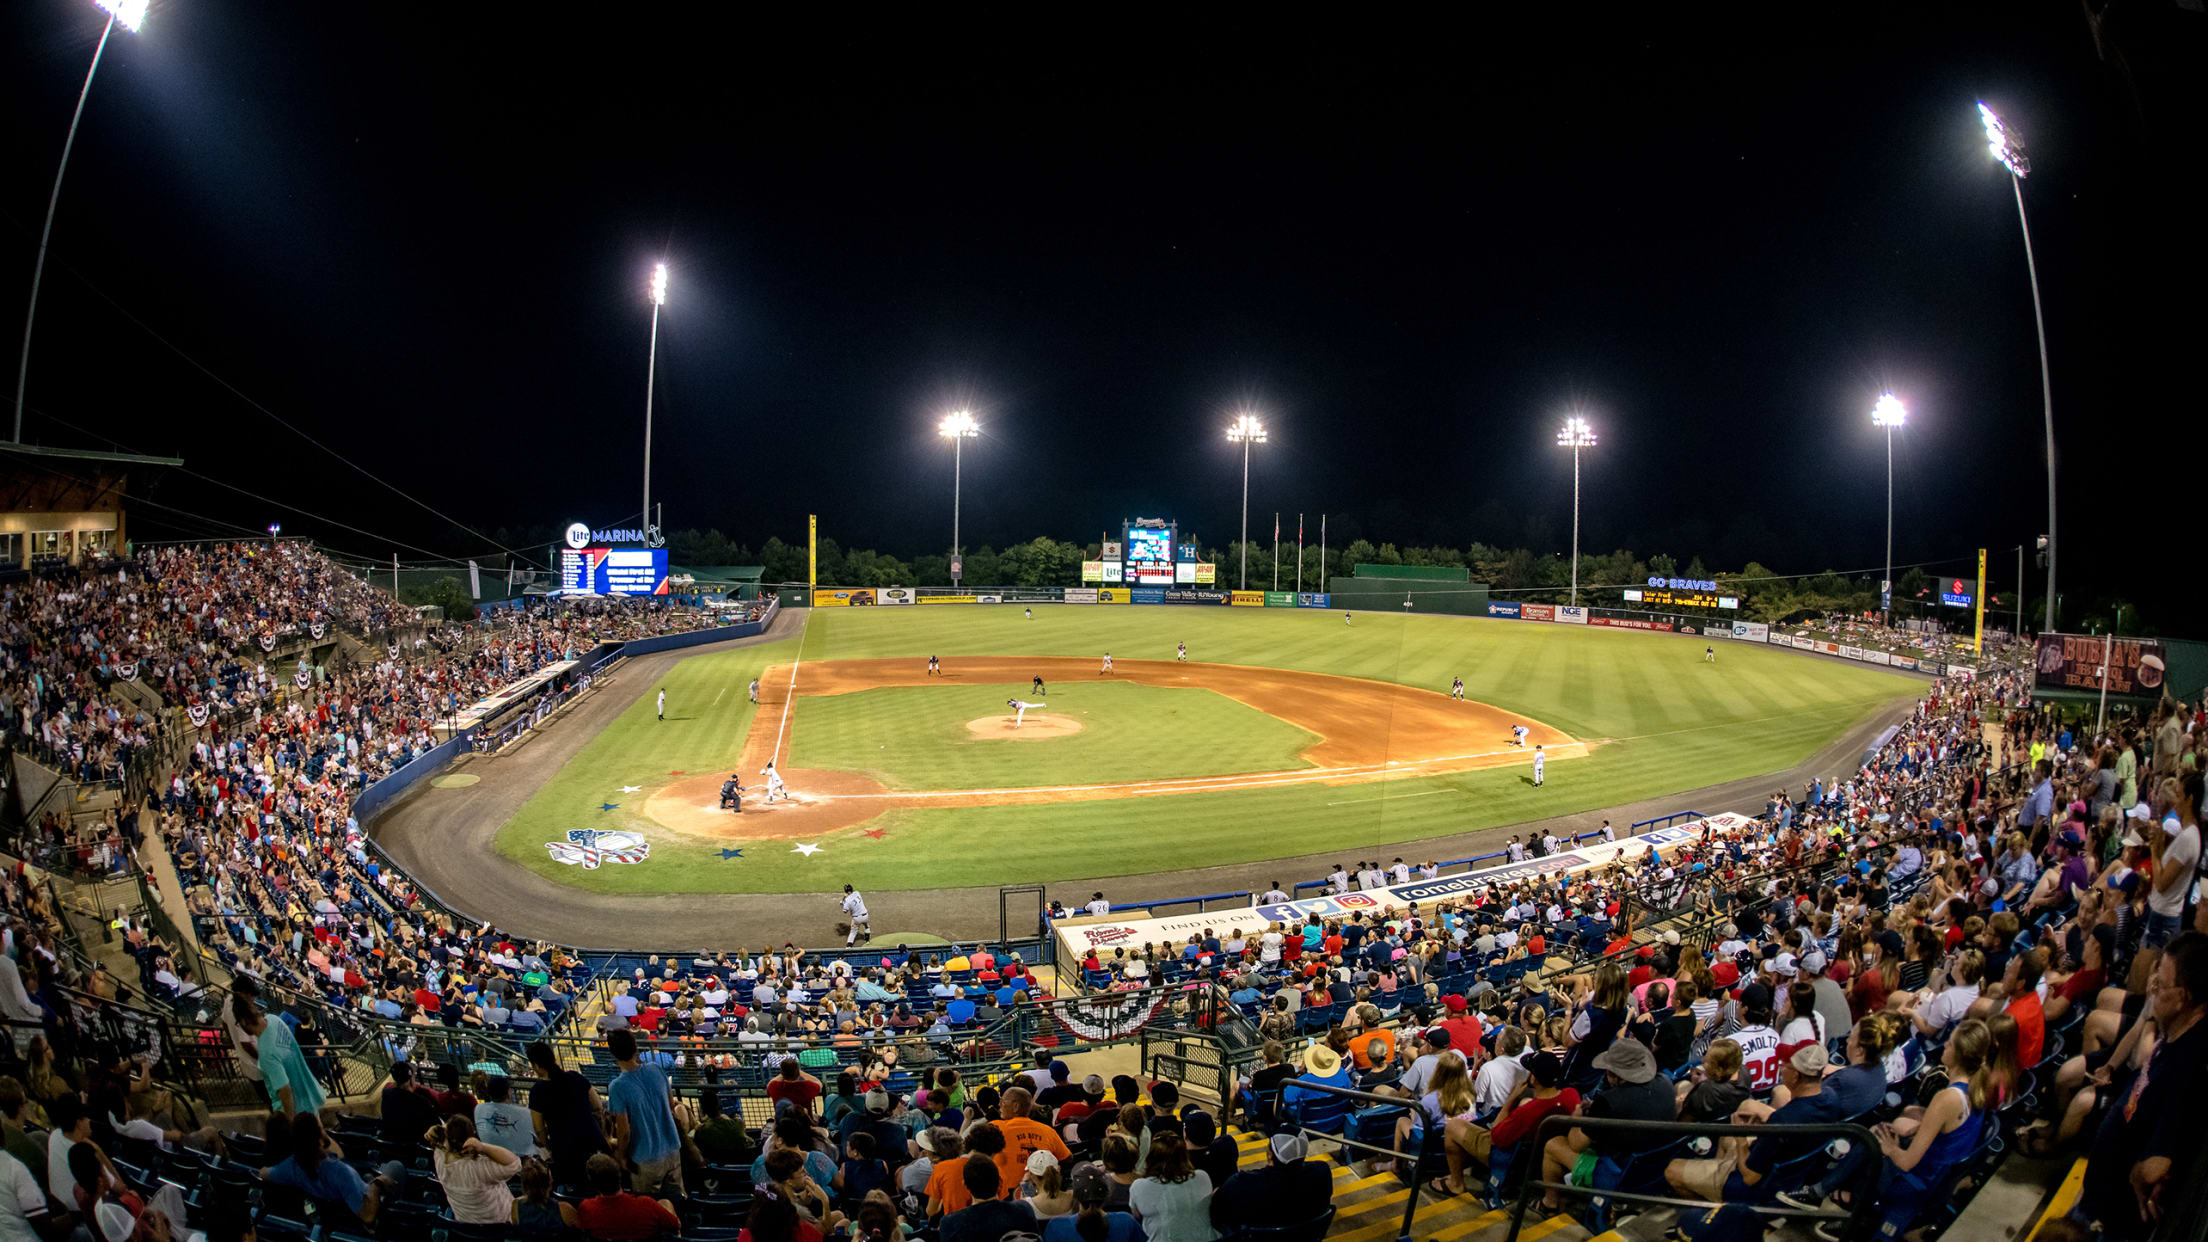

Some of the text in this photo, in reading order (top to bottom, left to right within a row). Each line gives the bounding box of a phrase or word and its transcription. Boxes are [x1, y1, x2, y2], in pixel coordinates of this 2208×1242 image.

[571, 529, 646, 543] Lite MARINA
[1106, 568, 1121, 578] Lite
[1647, 576, 1717, 591] GO BRAVES
[1942, 593, 1971, 604] SUZUKI
[1561, 606, 1581, 616] NGE
[2065, 673, 2132, 693] BARN
[1399, 854, 1584, 900] romebraves.com
[1097, 905, 1108, 913] 26
[1161, 921, 1201, 931] FIND
[1230, 914, 1255, 922] ON
[1741, 1035, 1778, 1056] SMOLTZ
